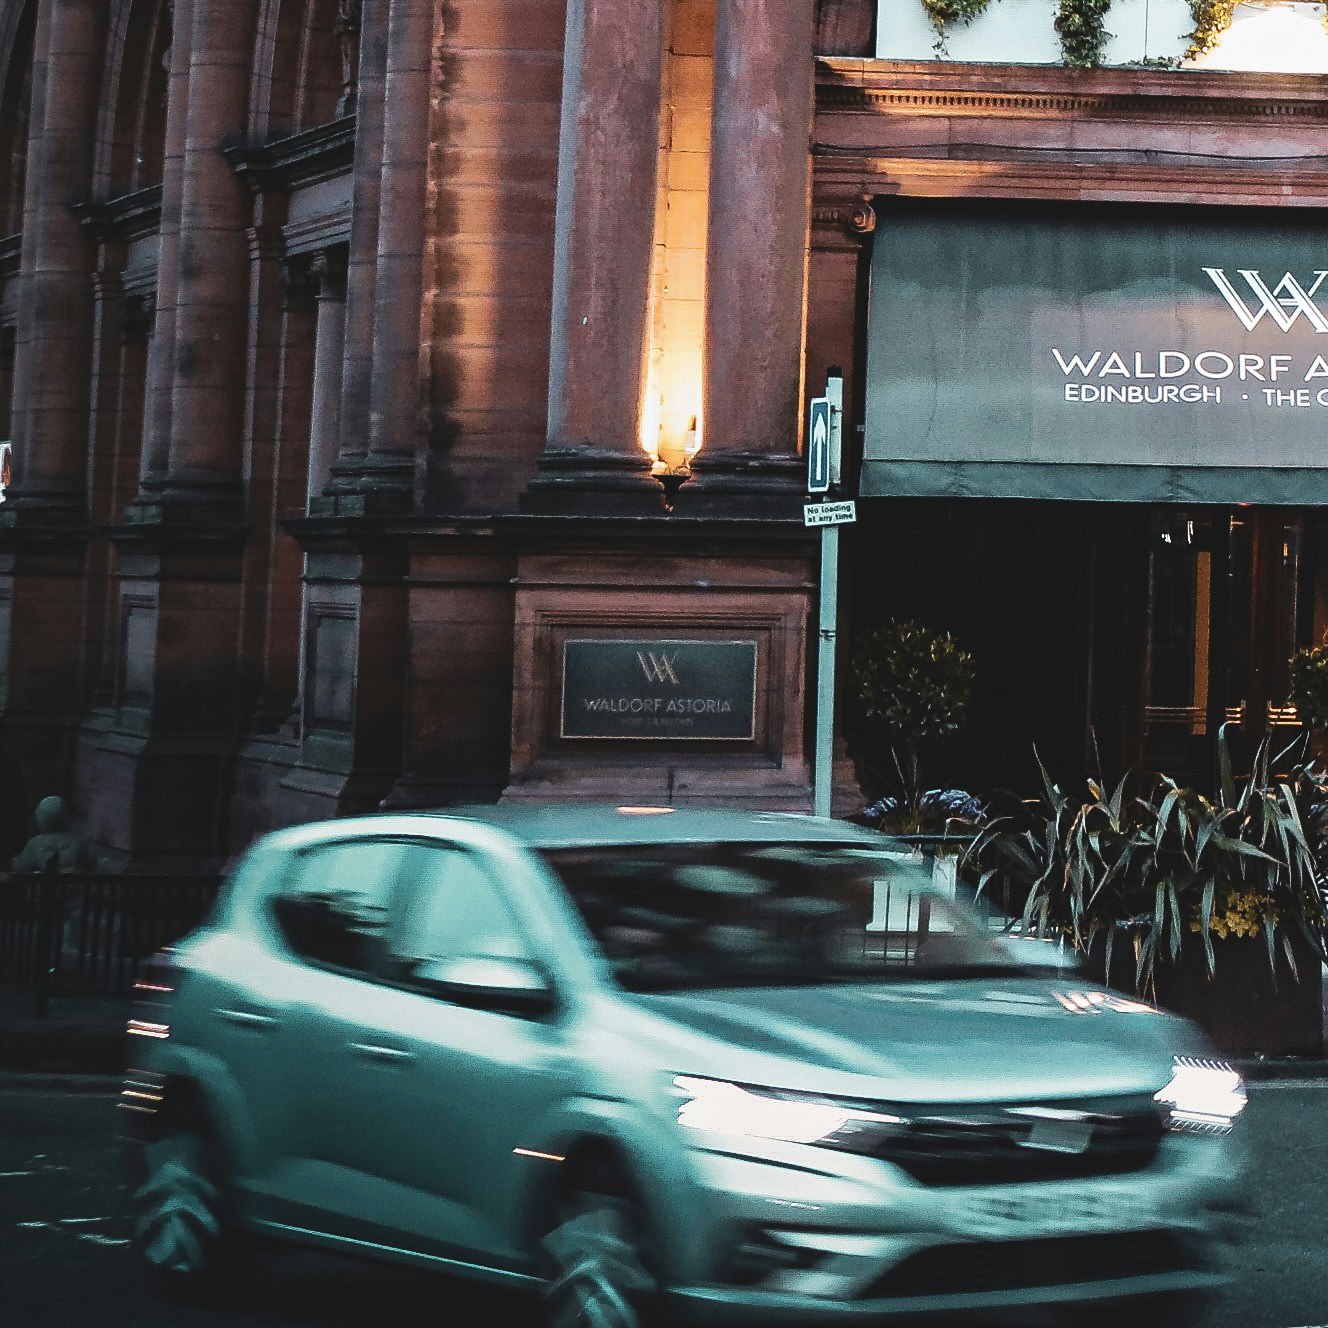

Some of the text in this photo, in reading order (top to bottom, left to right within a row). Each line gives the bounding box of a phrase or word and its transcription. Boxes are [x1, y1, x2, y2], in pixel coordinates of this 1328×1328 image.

[1051, 348, 1293, 382] WALDORF
[1063, 383, 1221, 405] EDINBURGH
[1263, 387, 1311, 407] THE
[821, 504, 851, 513] loading
[584, 697, 732, 714] WALDORF ASTORIA
